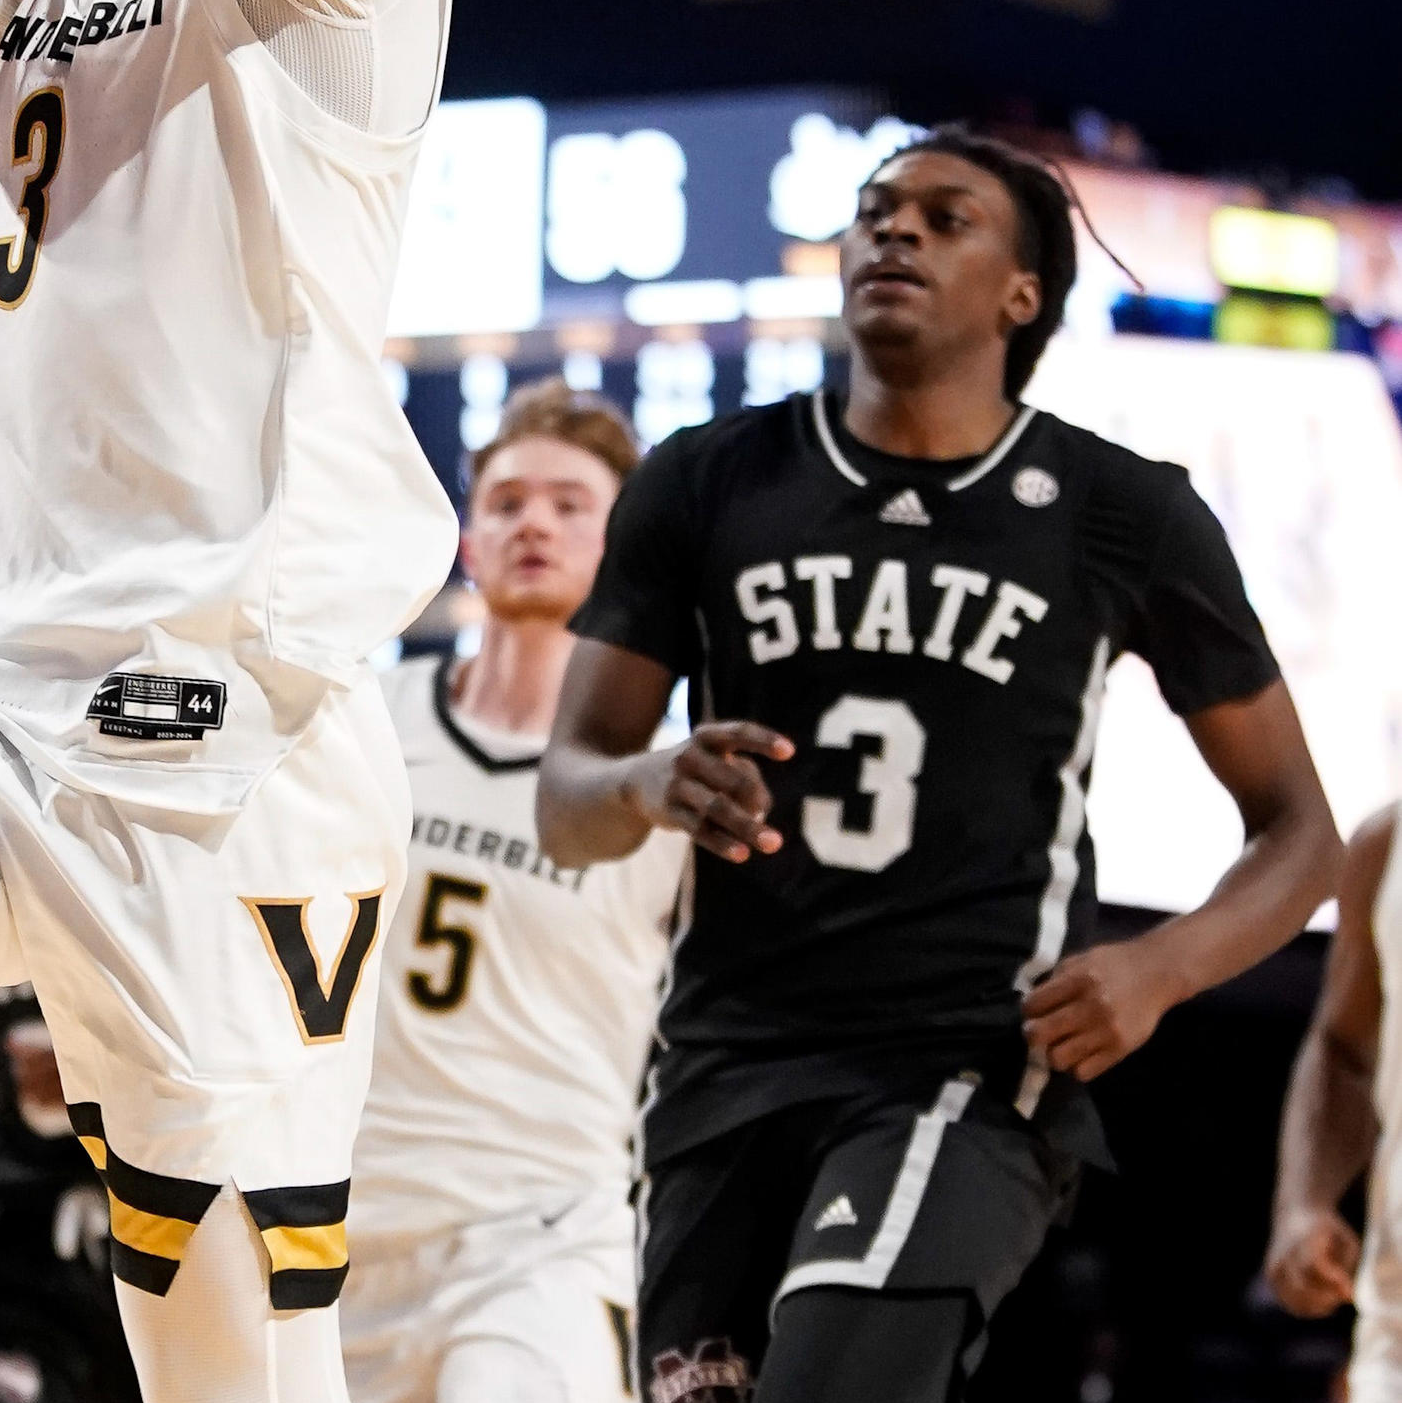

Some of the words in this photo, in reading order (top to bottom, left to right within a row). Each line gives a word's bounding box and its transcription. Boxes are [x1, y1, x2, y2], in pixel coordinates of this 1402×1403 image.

[734, 554, 1050, 686] STATE
[187, 694, 213, 714] 44
[801, 695, 928, 873] 3
[237, 884, 388, 1046] V
[405, 871, 490, 1018] 5
